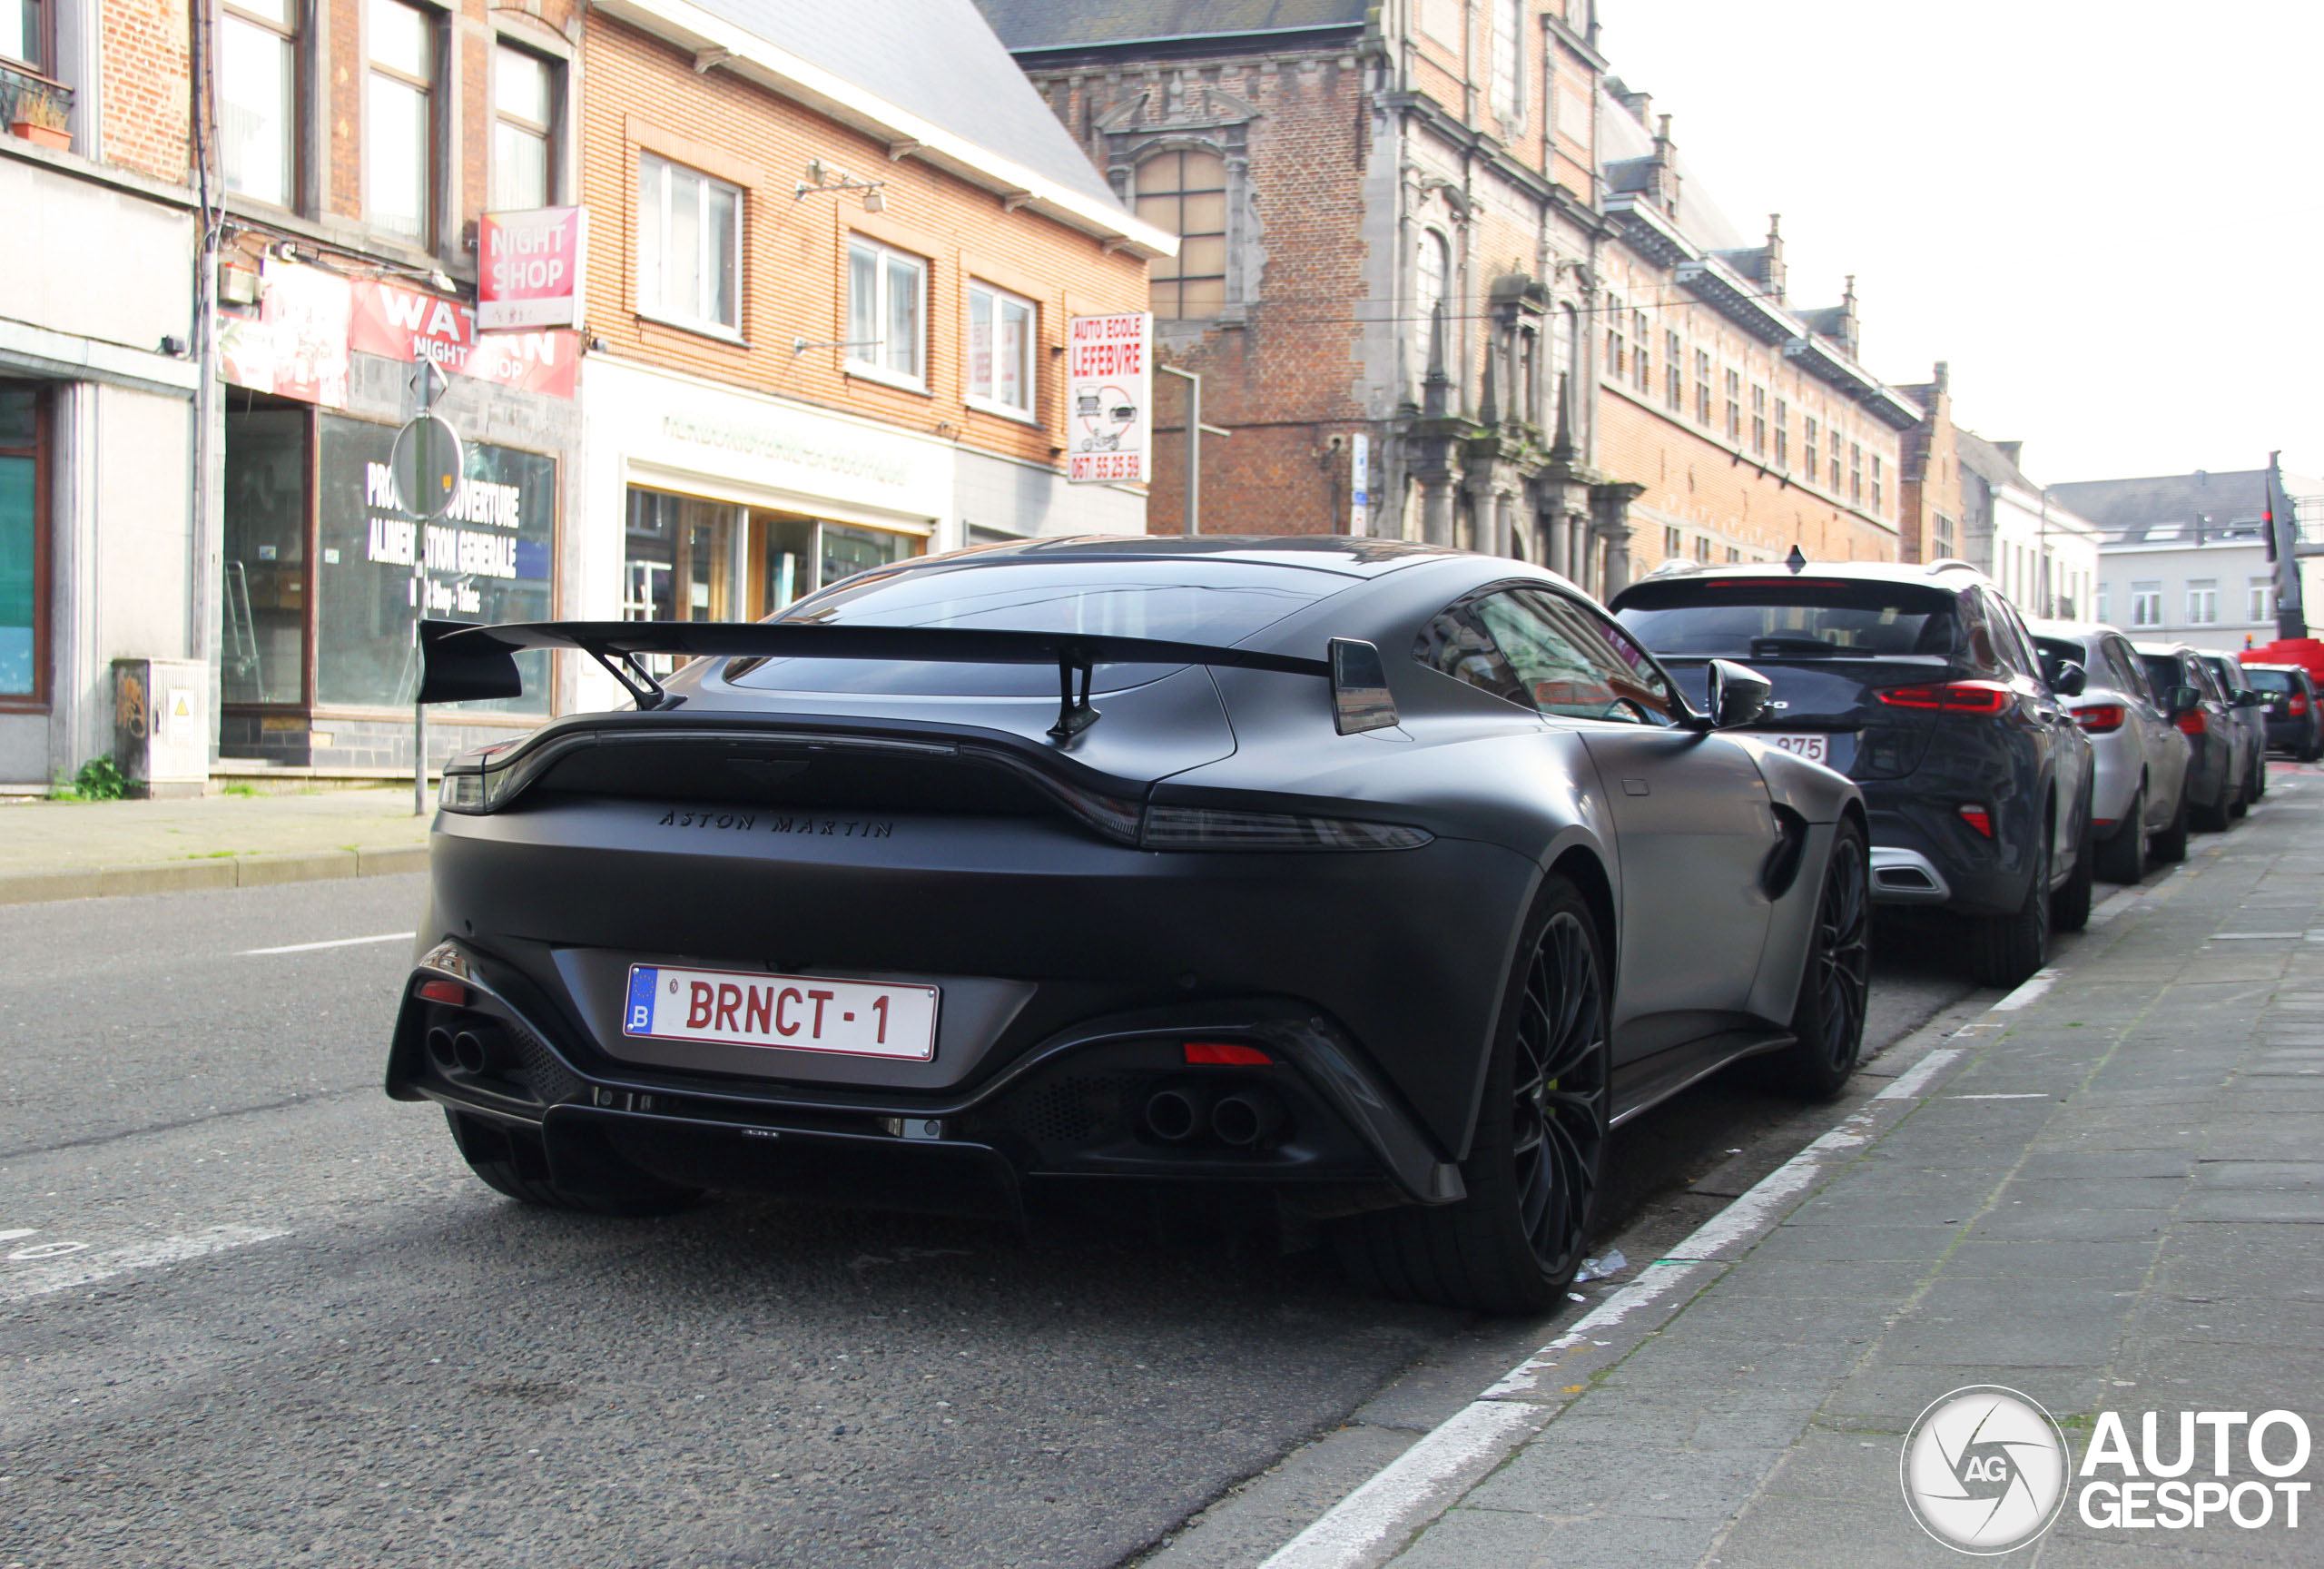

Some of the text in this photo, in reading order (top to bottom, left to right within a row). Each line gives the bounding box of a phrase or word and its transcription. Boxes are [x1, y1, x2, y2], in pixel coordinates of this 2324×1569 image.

[490, 223, 567, 258] NIGHT
[491, 259, 565, 292] SHOP
[1073, 317, 1141, 340] AUTO ECOLE
[413, 335, 524, 380] NIGHT HOP
[1072, 342, 1140, 378] LEFEBVRE
[1096, 456, 1108, 479] 55
[1110, 455, 1124, 479] 25
[367, 517, 517, 579] ALIMENTION GENERALE
[1777, 736, 1823, 760] 975
[659, 809, 894, 838] ASTON MARTIN
[633, 1005, 649, 1028] B
